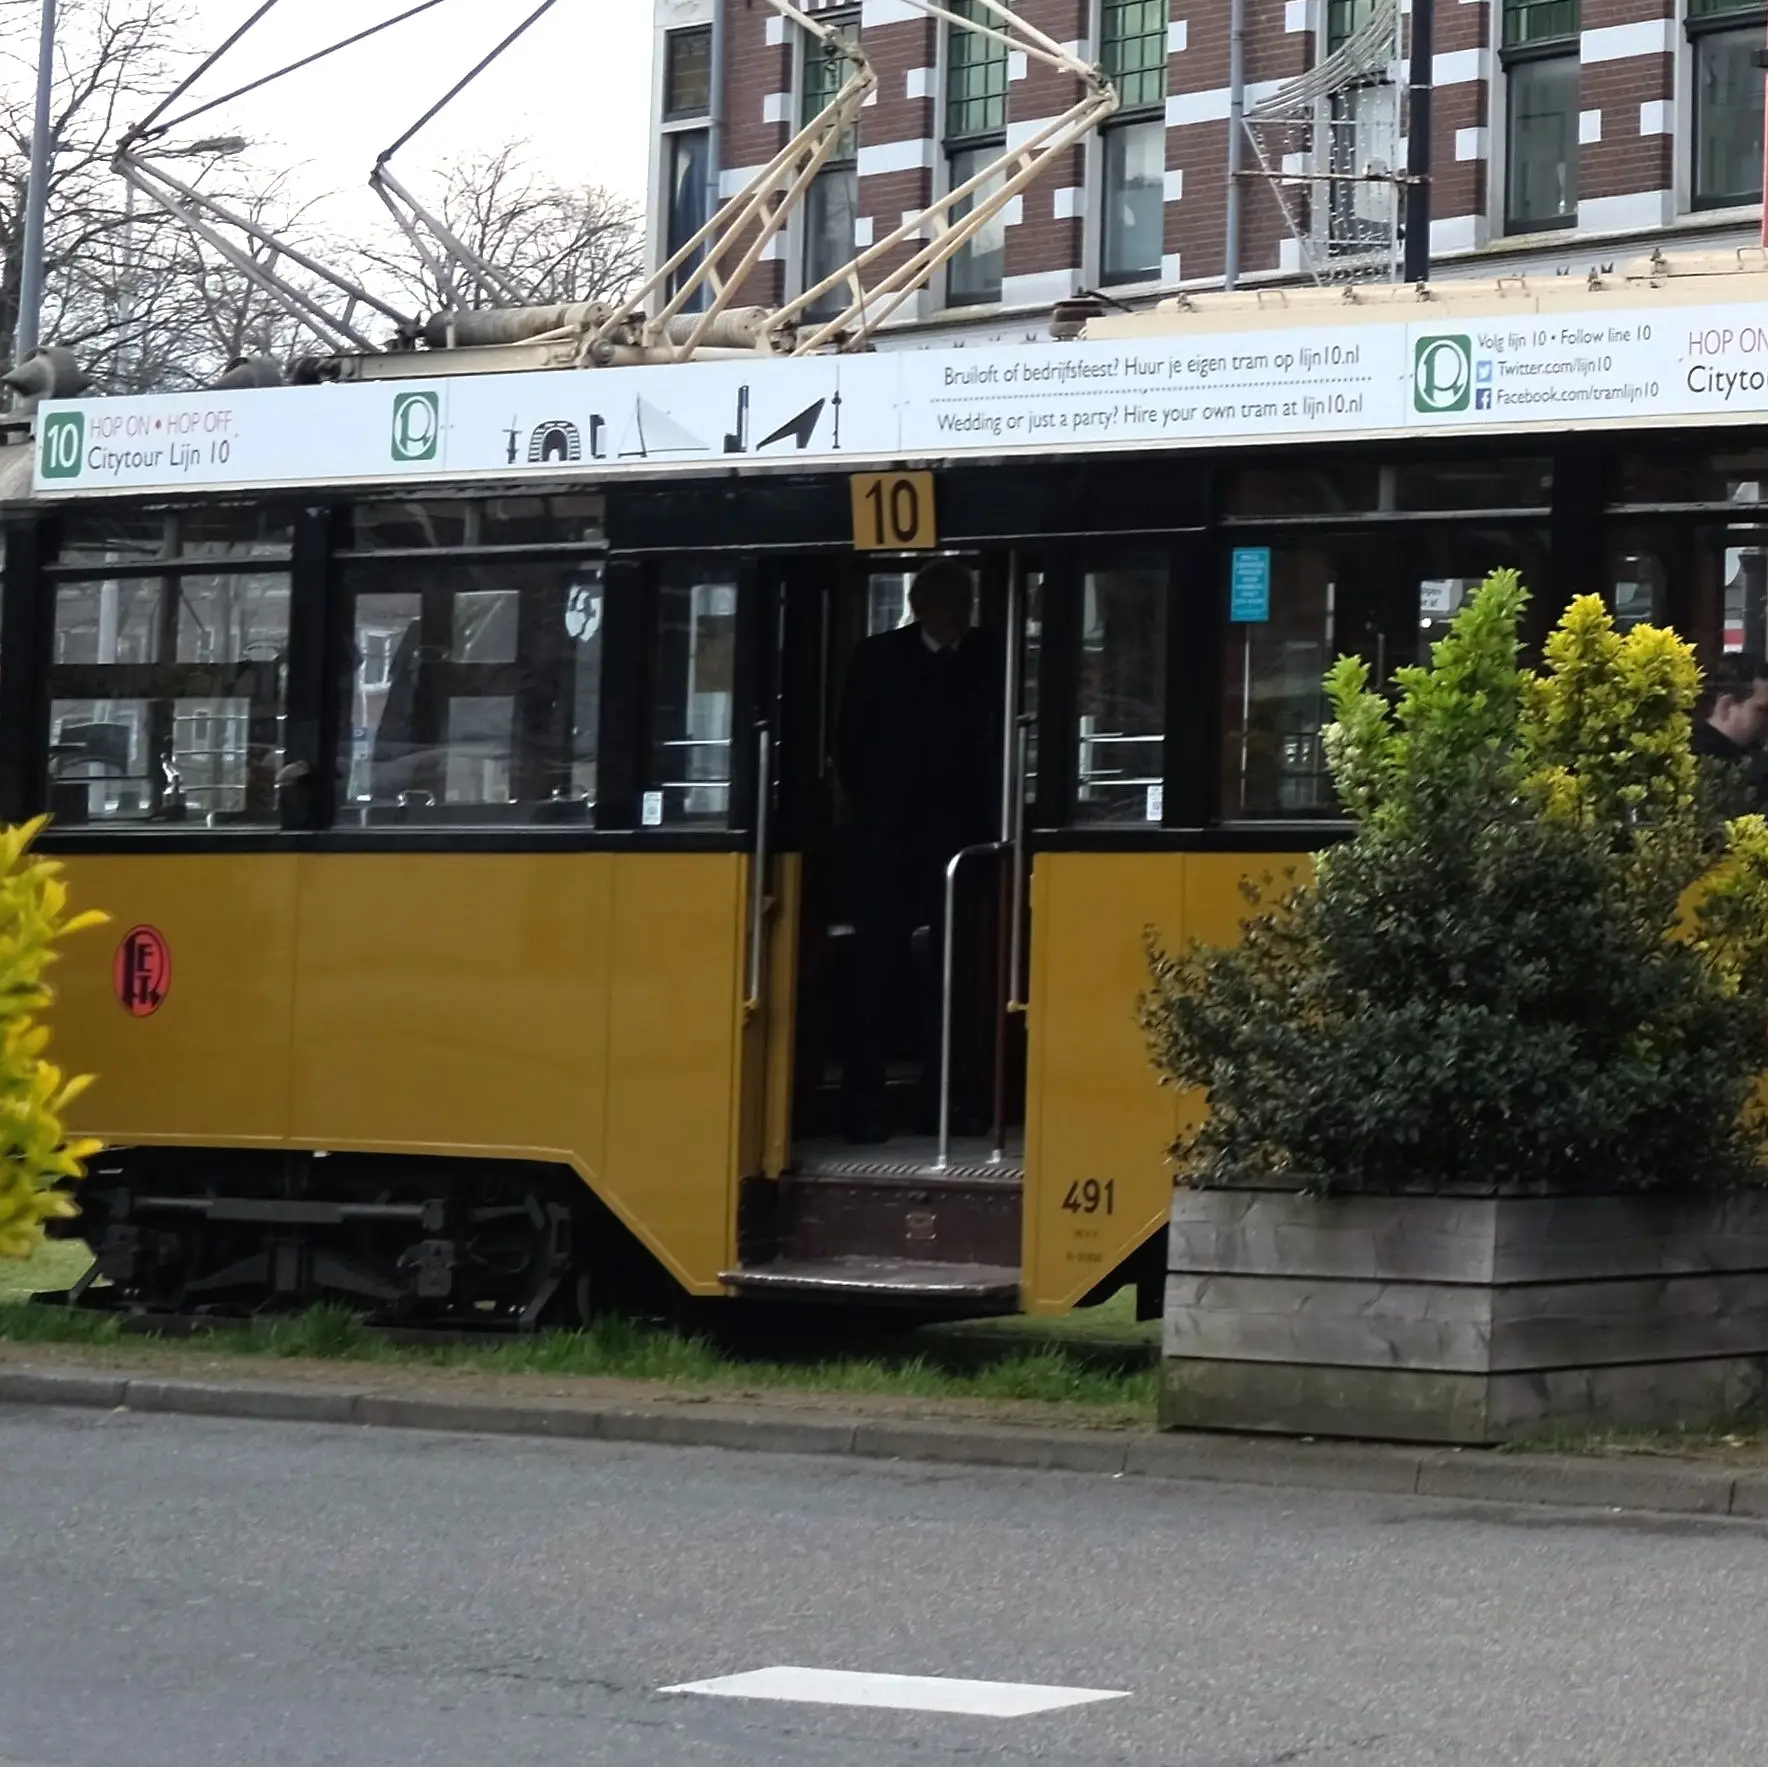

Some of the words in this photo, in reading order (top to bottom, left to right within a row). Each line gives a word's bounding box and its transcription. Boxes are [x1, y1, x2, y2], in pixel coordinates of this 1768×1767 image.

[1689, 329, 1733, 355] HOP
[945, 364, 998, 385] Bruiloft
[1004, 363, 1019, 382] of
[1023, 358, 1119, 384] bedrijfsfeest?
[1125, 357, 1164, 376] Huur
[1169, 360, 1182, 379] je
[1188, 355, 1226, 378] eigen
[1232, 356, 1268, 370] tram
[1274, 354, 1294, 373] op
[1300, 344, 1359, 371] lijn10.nl
[91, 417, 122, 438] HOP
[127, 415, 149, 437] ON
[169, 413, 199, 433] HOP
[205, 411, 231, 432] OFF
[938, 413, 1001, 436] Wedding
[1007, 416, 1024, 429] or
[1029, 414, 1056, 433] just
[1060, 414, 1067, 426] a
[1073, 406, 1118, 431] party?
[1124, 405, 1157, 423] Hire
[1163, 408, 1197, 427] your
[1202, 406, 1235, 420] own
[1241, 404, 1277, 418] tram
[1282, 401, 1297, 416] at
[1303, 394, 1362, 420] lijn10.nl
[46, 422, 80, 469] 10
[88, 446, 163, 476] Citytour
[170, 443, 200, 472] Lijn
[210, 434, 230, 464] 10
[865, 478, 919, 544] 10
[1061, 1178, 1115, 1216] 491
